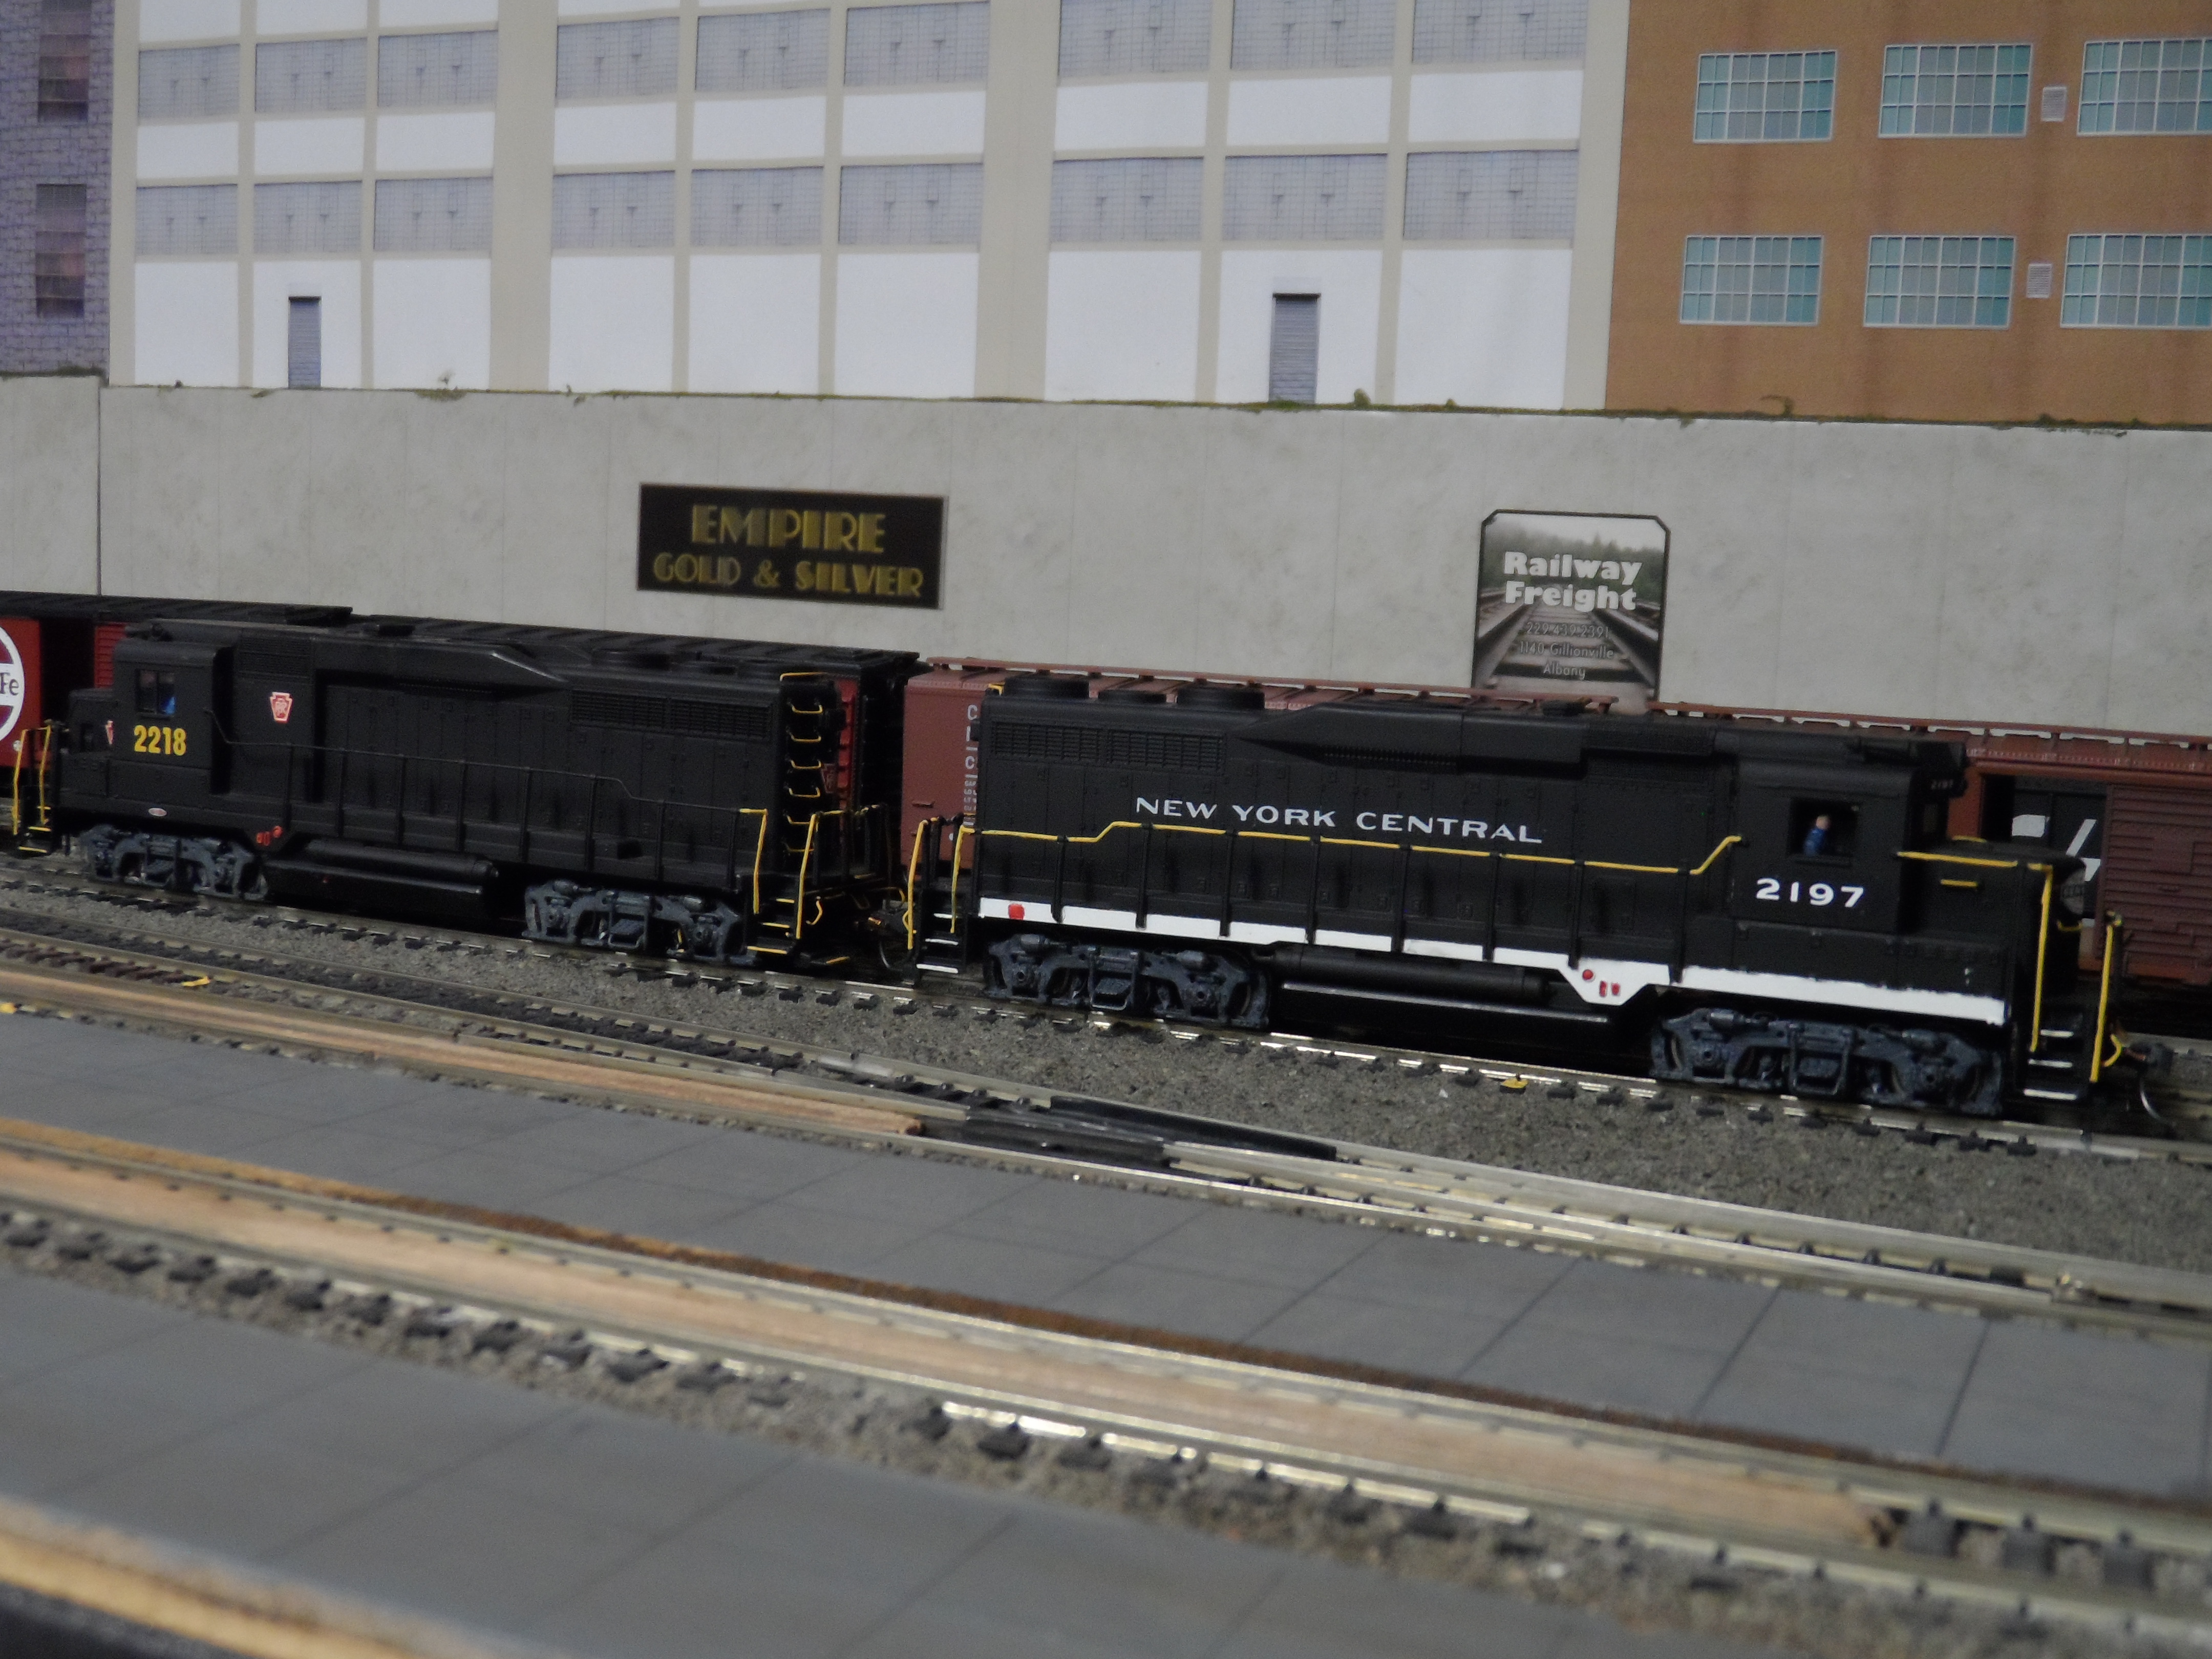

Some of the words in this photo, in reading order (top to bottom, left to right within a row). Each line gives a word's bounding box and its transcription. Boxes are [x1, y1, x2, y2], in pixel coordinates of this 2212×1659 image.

[691, 504, 886, 554] EMPIRE
[653, 552, 741, 586] GOLD
[753, 560, 779, 587] &
[796, 561, 924, 598] SILVER
[1503, 551, 1642, 585] Railway
[1505, 580, 1636, 612] Freight
[1520, 641, 1544, 654] 1140
[1550, 643, 1614, 659] Gillionville
[0, 672, 19, 695] Fe
[1543, 660, 1585, 680] Albany
[134, 725, 186, 756] 2218
[1136, 797, 1217, 819] NEW
[1232, 805, 1336, 827] YORK
[1356, 812, 1543, 844] CENTRAL
[1756, 878, 1864, 908] 2197
